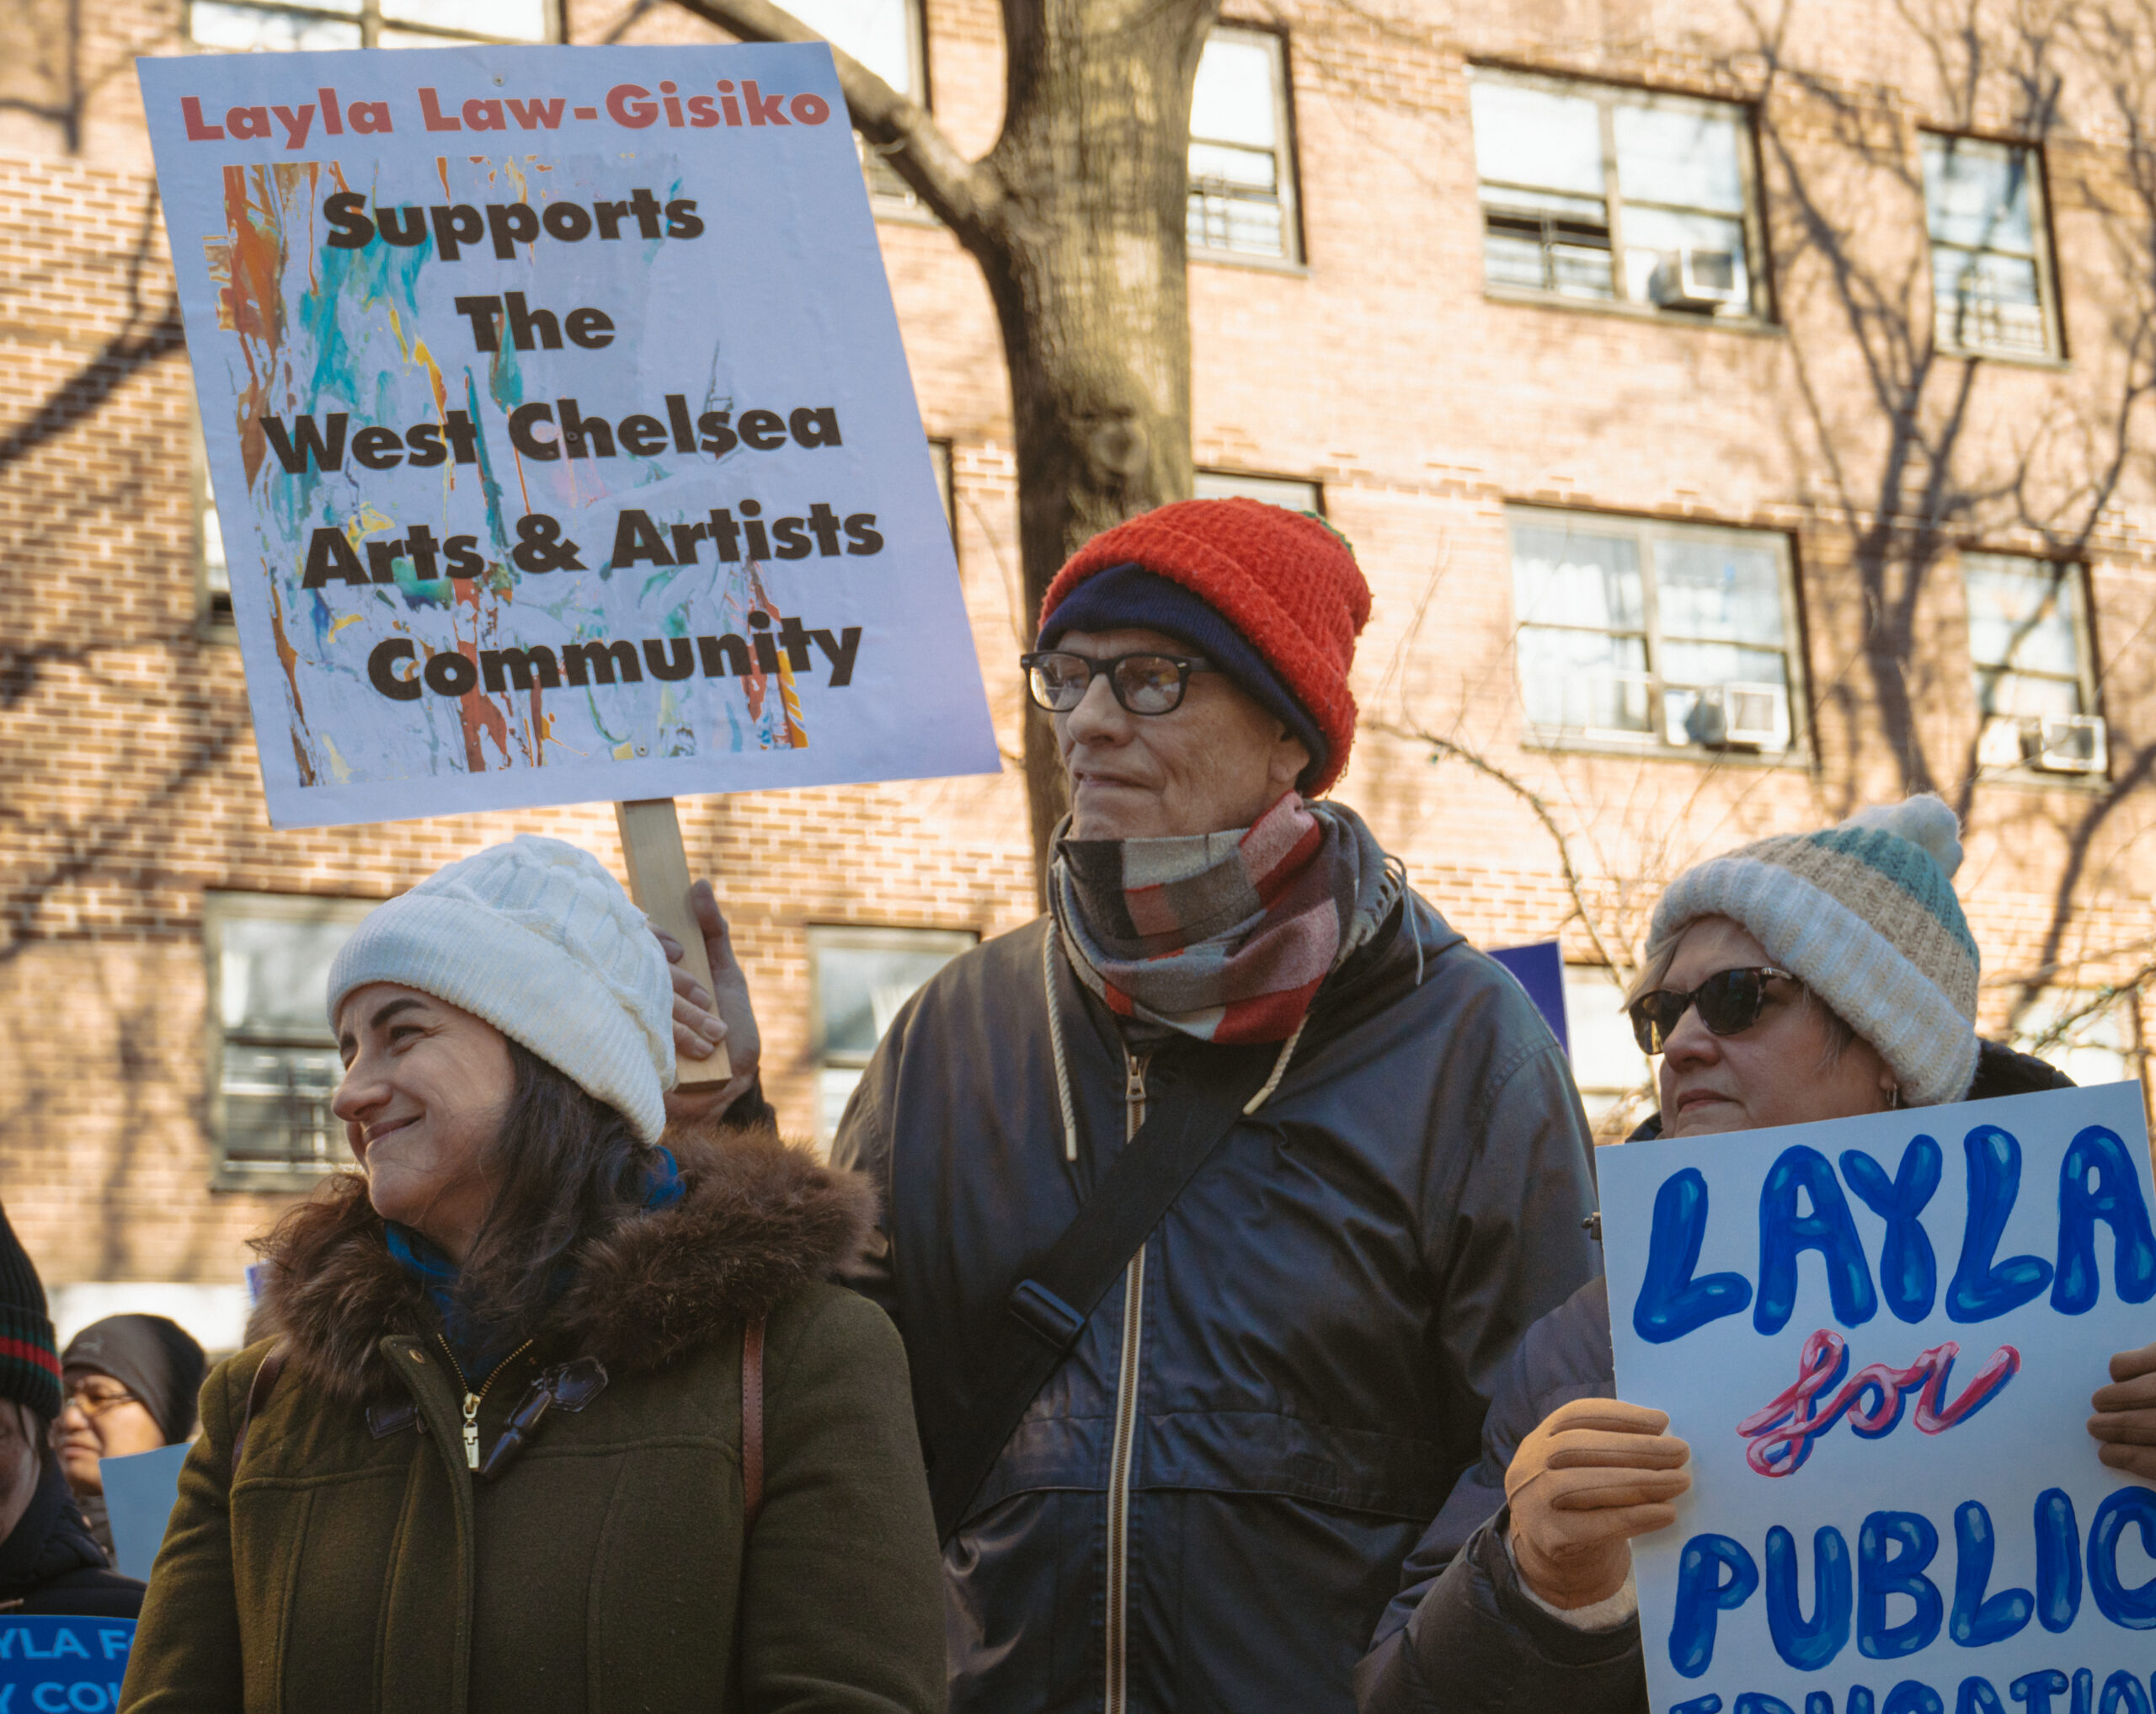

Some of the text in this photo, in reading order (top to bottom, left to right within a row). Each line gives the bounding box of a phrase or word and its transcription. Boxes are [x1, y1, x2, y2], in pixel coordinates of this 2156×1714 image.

[180, 80, 831, 150] Layla Law-Gisiko
[322, 188, 705, 262] Supports
[455, 291, 616, 353] The
[259, 394, 842, 474] West Chelsea
[301, 499, 884, 590] Arts & Artists
[366, 611, 862, 701] Community
[1633, 1124, 2156, 1344] LAYLA
[1736, 1329, 2021, 1477] for
[1668, 1487, 2156, 1679] PUBLIC
[0, 1627, 91, 1659] YLA
